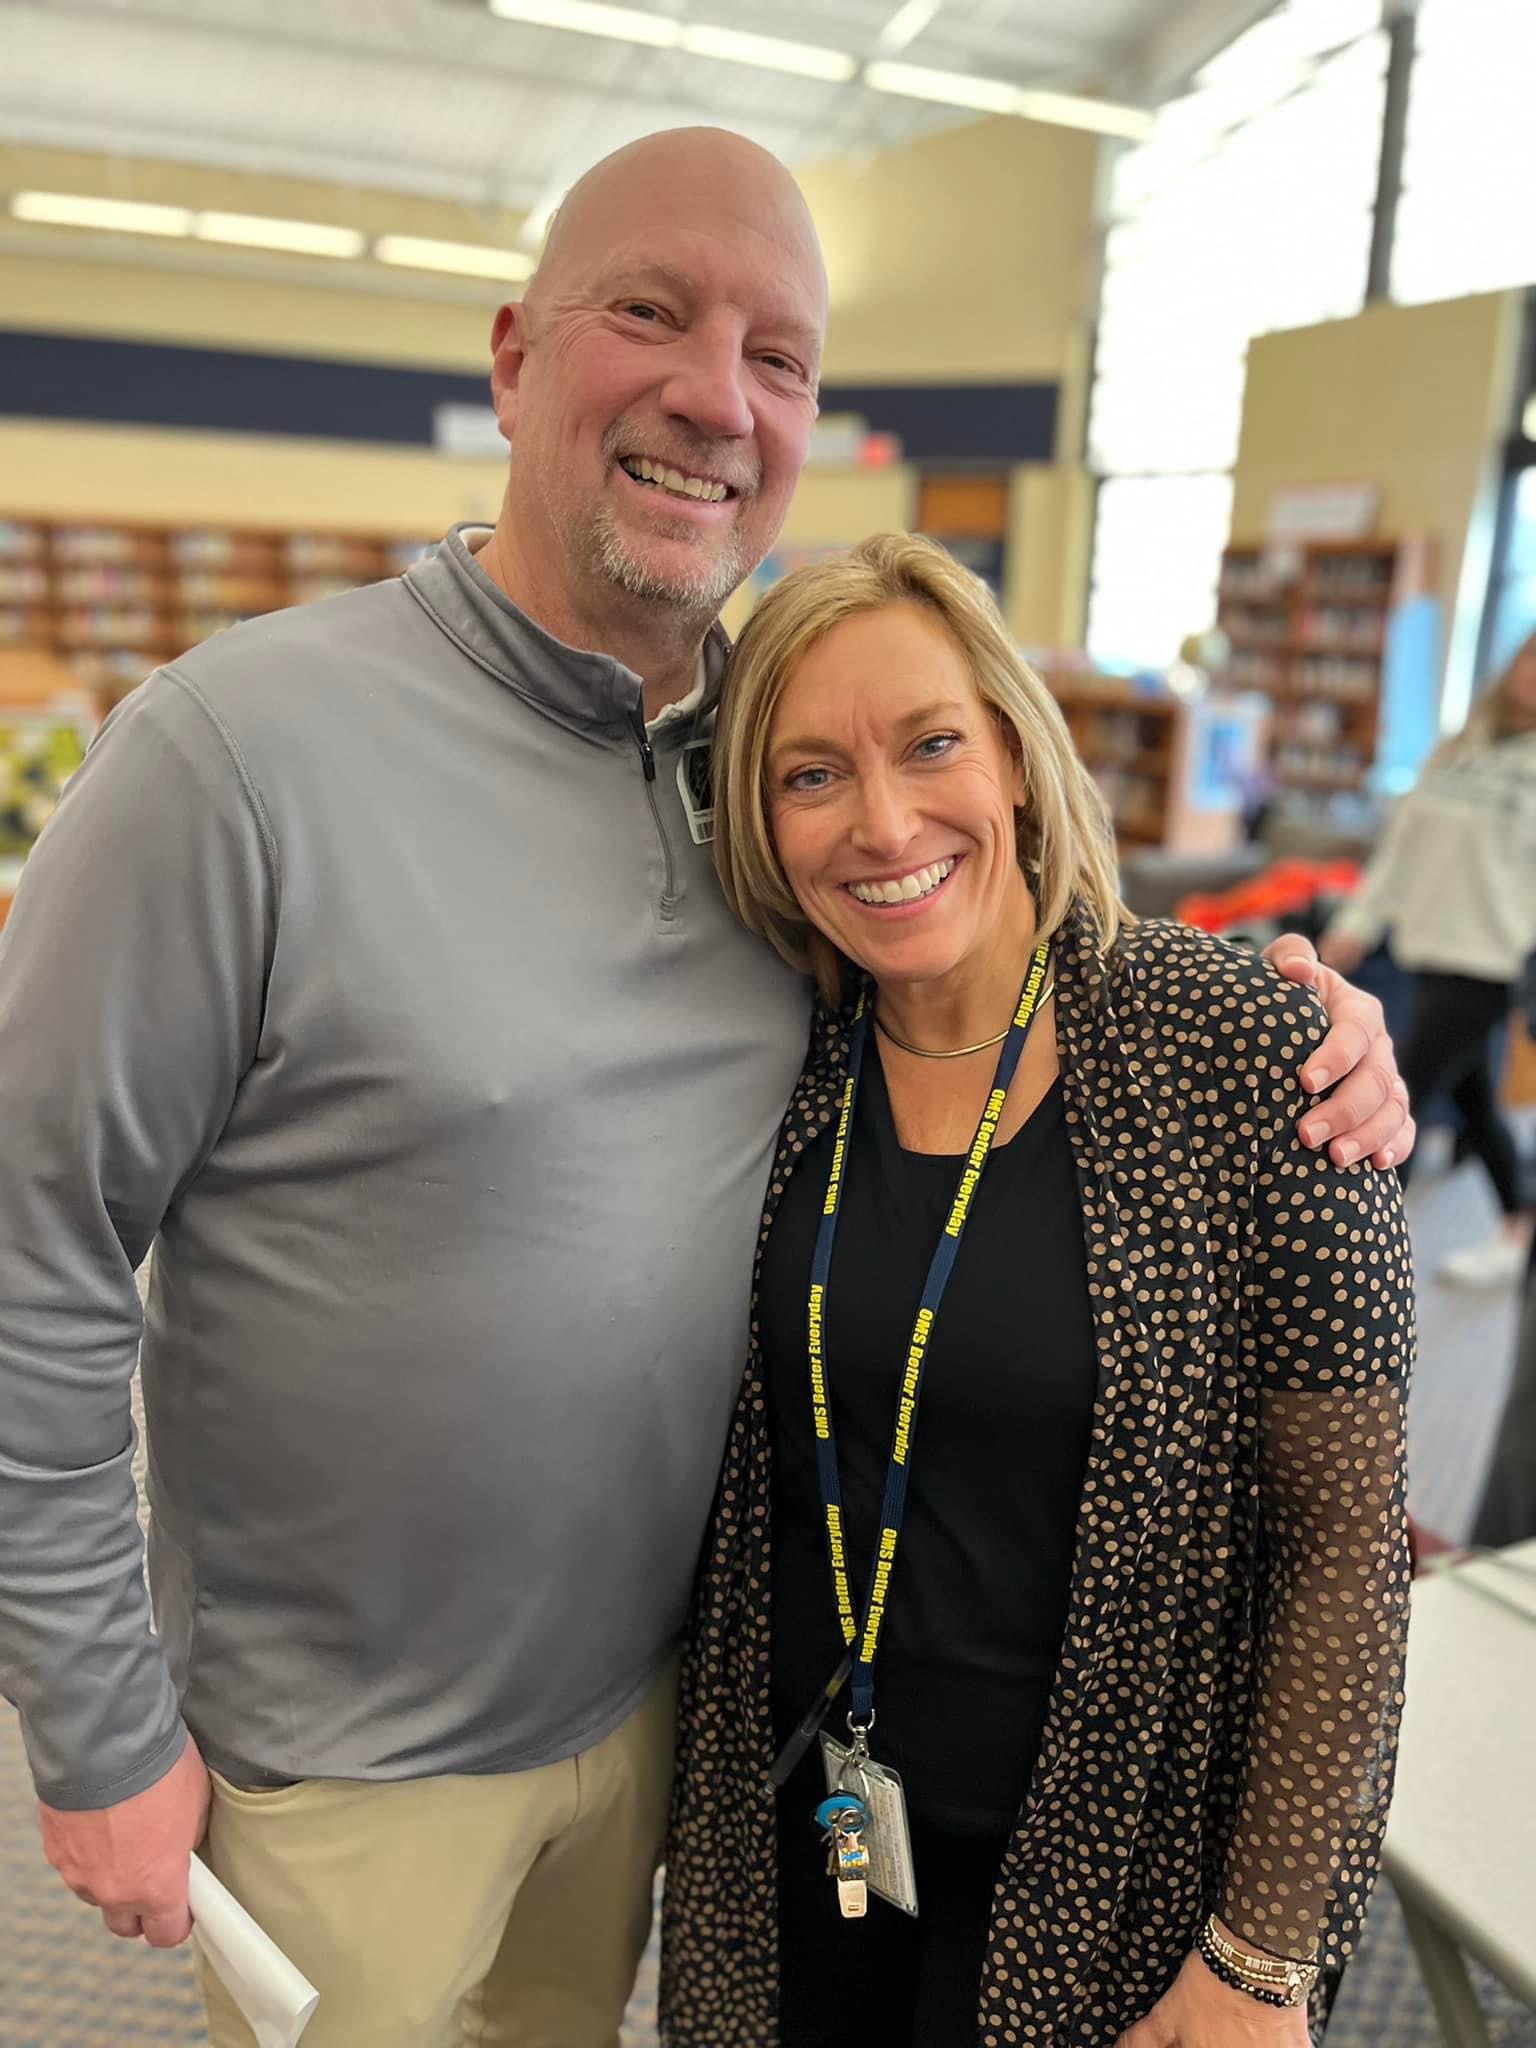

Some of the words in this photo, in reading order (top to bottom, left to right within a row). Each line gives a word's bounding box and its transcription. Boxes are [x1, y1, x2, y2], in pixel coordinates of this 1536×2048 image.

[1013, 966, 1045, 1029] Everyday
[984, 1088, 1006, 1121] OMS
[829, 1139, 845, 1182] Better
[968, 1121, 995, 1169] Better
[823, 1183, 839, 1215] OMS
[945, 1168, 980, 1238] Everyday
[808, 1284, 824, 1355] Everyday
[912, 1308, 934, 1345] OMS
[811, 1356, 826, 1405] Better
[902, 1345, 924, 1398] Better
[813, 1406, 830, 1439] OMS
[893, 1396, 915, 1466] Everyday
[826, 1503, 845, 1568] Everyday
[879, 1527, 898, 1560] OMS
[834, 1569, 852, 1615] Better
[872, 1560, 892, 1605] Better
[840, 1616, 857, 1646] MS
[859, 1605, 884, 1663] Everyday
